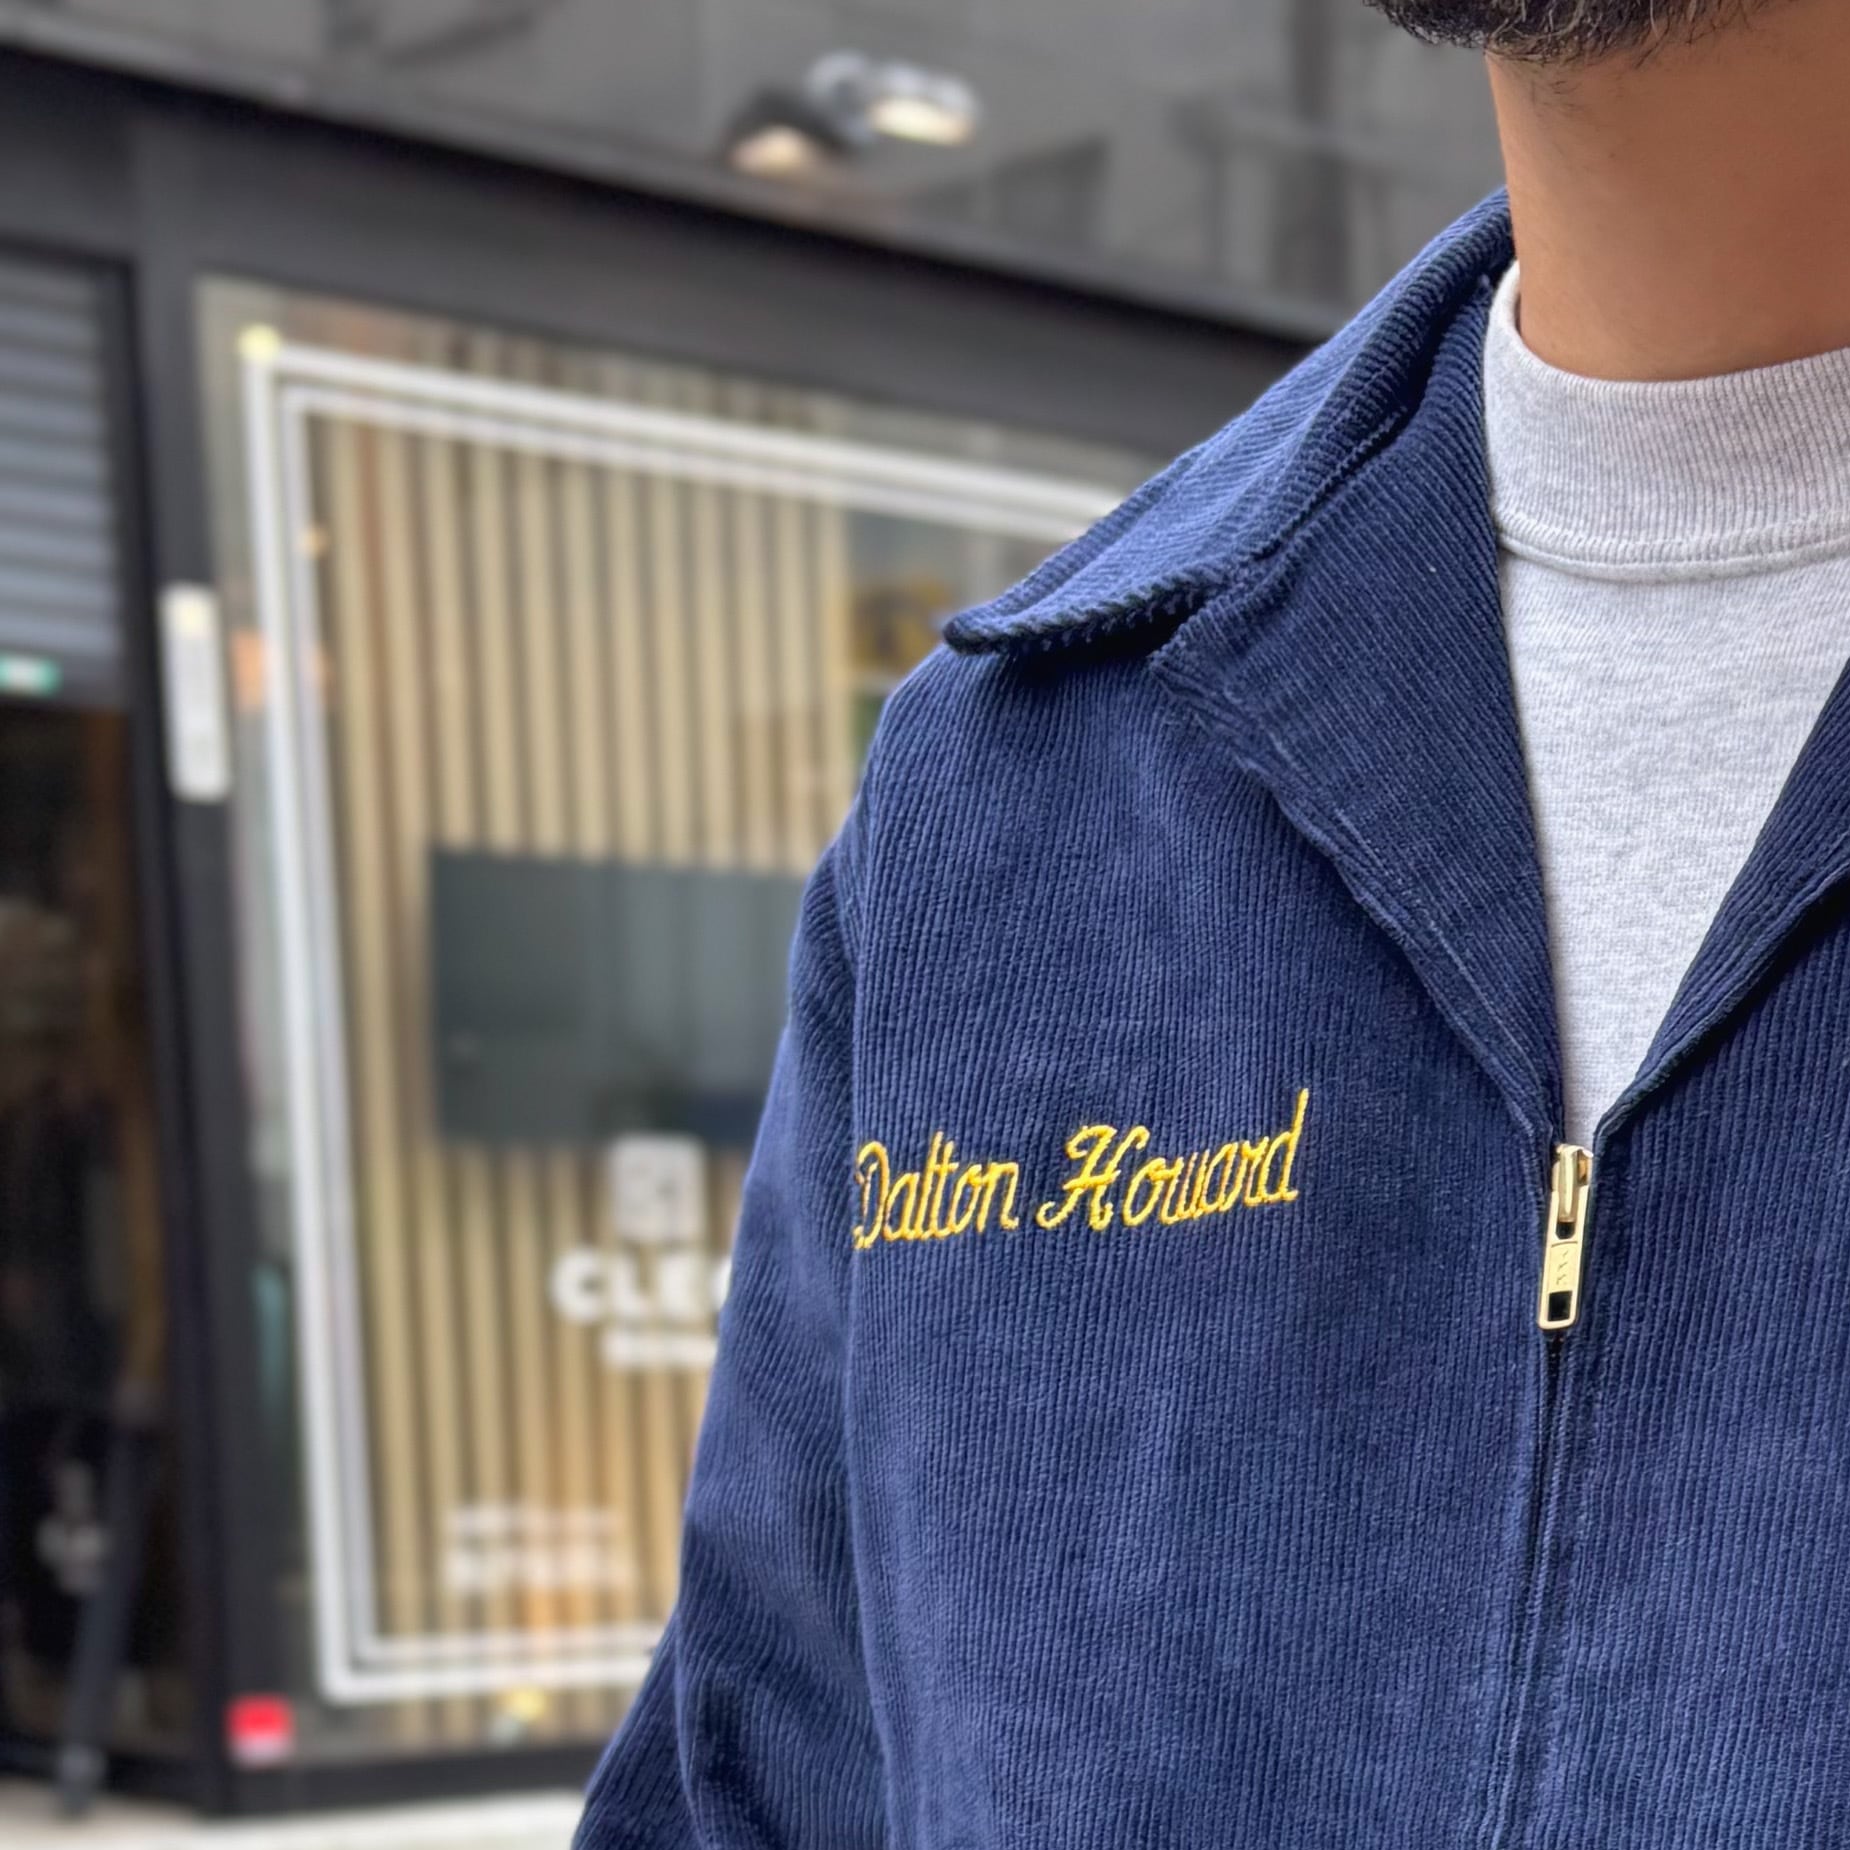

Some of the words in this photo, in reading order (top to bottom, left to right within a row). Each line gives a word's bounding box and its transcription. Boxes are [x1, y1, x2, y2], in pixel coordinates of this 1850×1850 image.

[854, 1130, 1020, 1250] Dalton
[1036, 1087, 1310, 1230] Howard
[549, 1246, 734, 1324] CLE
